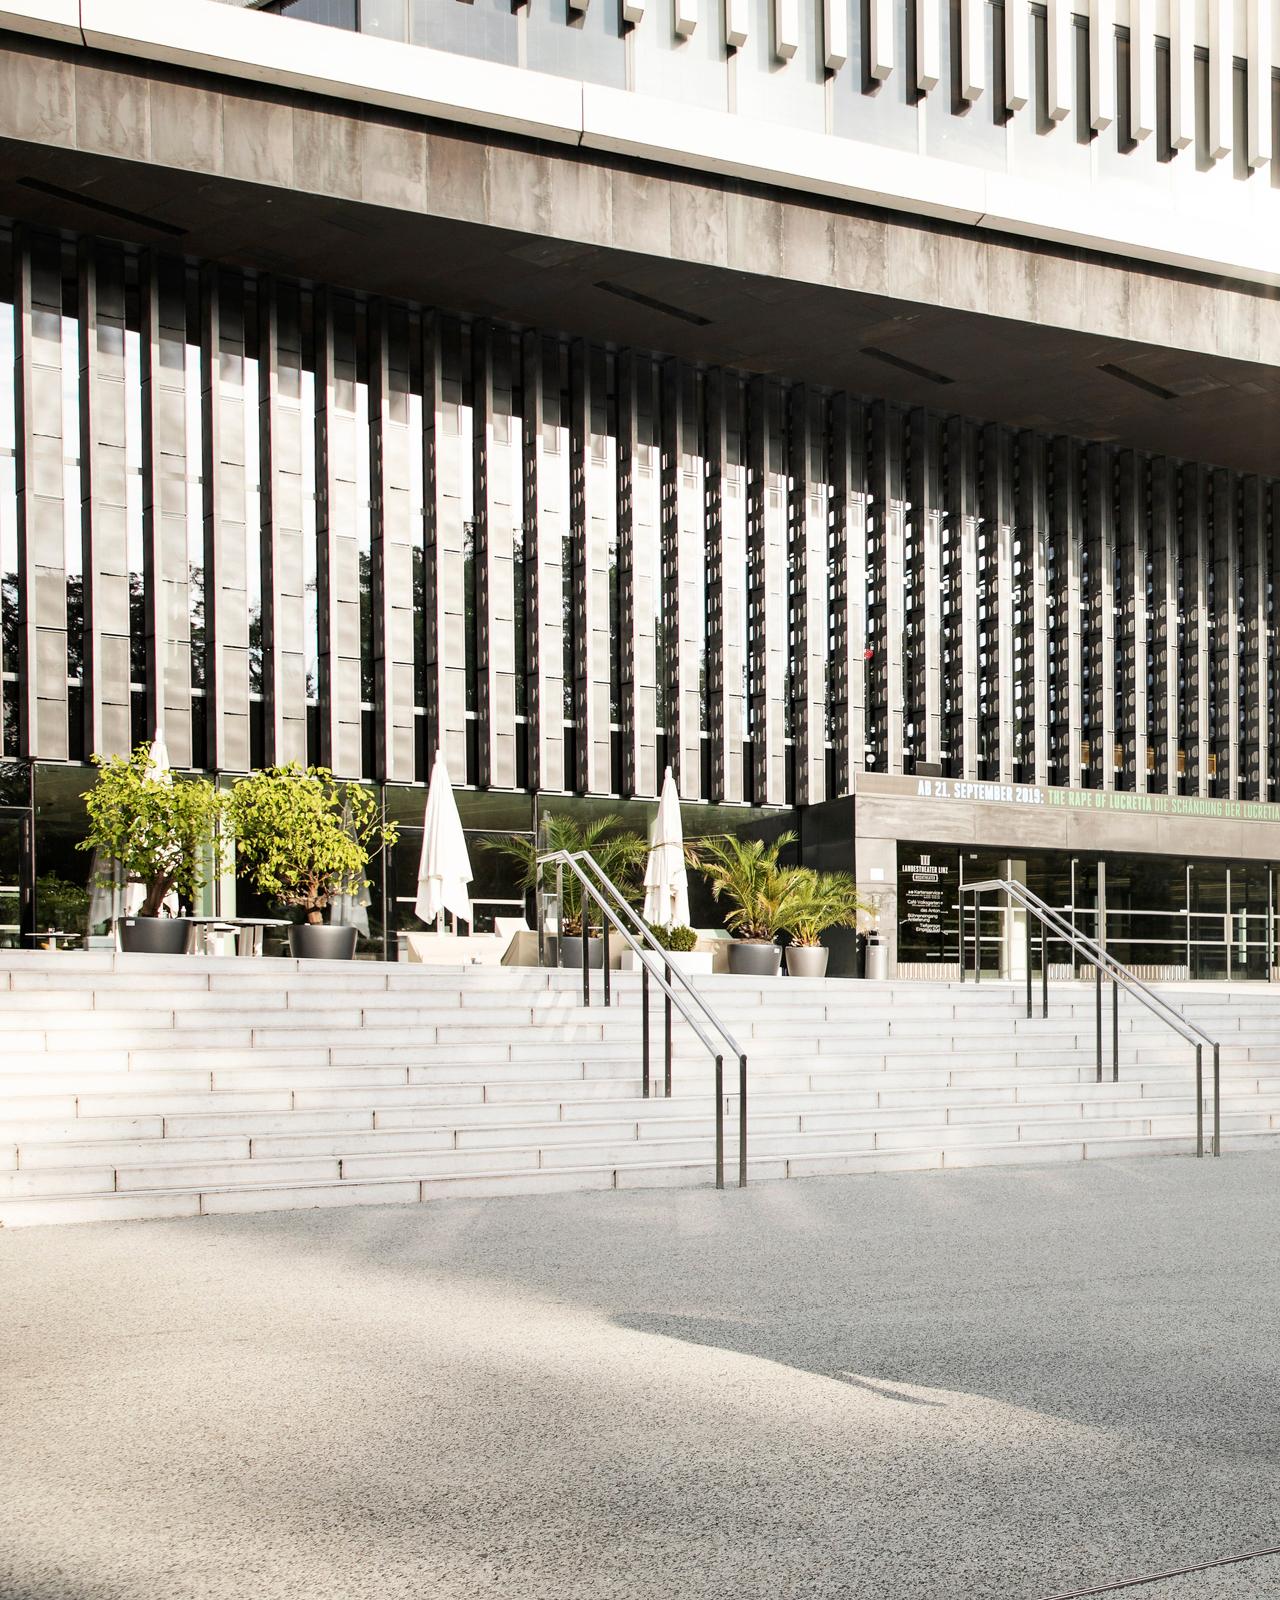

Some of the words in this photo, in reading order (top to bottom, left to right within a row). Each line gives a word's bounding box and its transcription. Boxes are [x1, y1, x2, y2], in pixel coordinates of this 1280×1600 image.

[918, 780, 932, 796] AB
[934, 781, 950, 797] 21.
[954, 783, 1012, 802] SEPTEMBER
[1016, 788, 1044, 804] 2019:
[1048, 790, 1065, 805] THE
[1068, 792, 1092, 807] RAPE
[1096, 793, 1106, 808] OF
[1110, 794, 1152, 811] LUCRETIA
[1155, 798, 1168, 812] DIE
[1172, 798, 1222, 816] SCHÄNDUNG
[1225, 803, 1240, 817] DER
[1243, 804, 1280, 820] LUCRETIA
[902, 865, 937, 873] LANDESTHEATER
